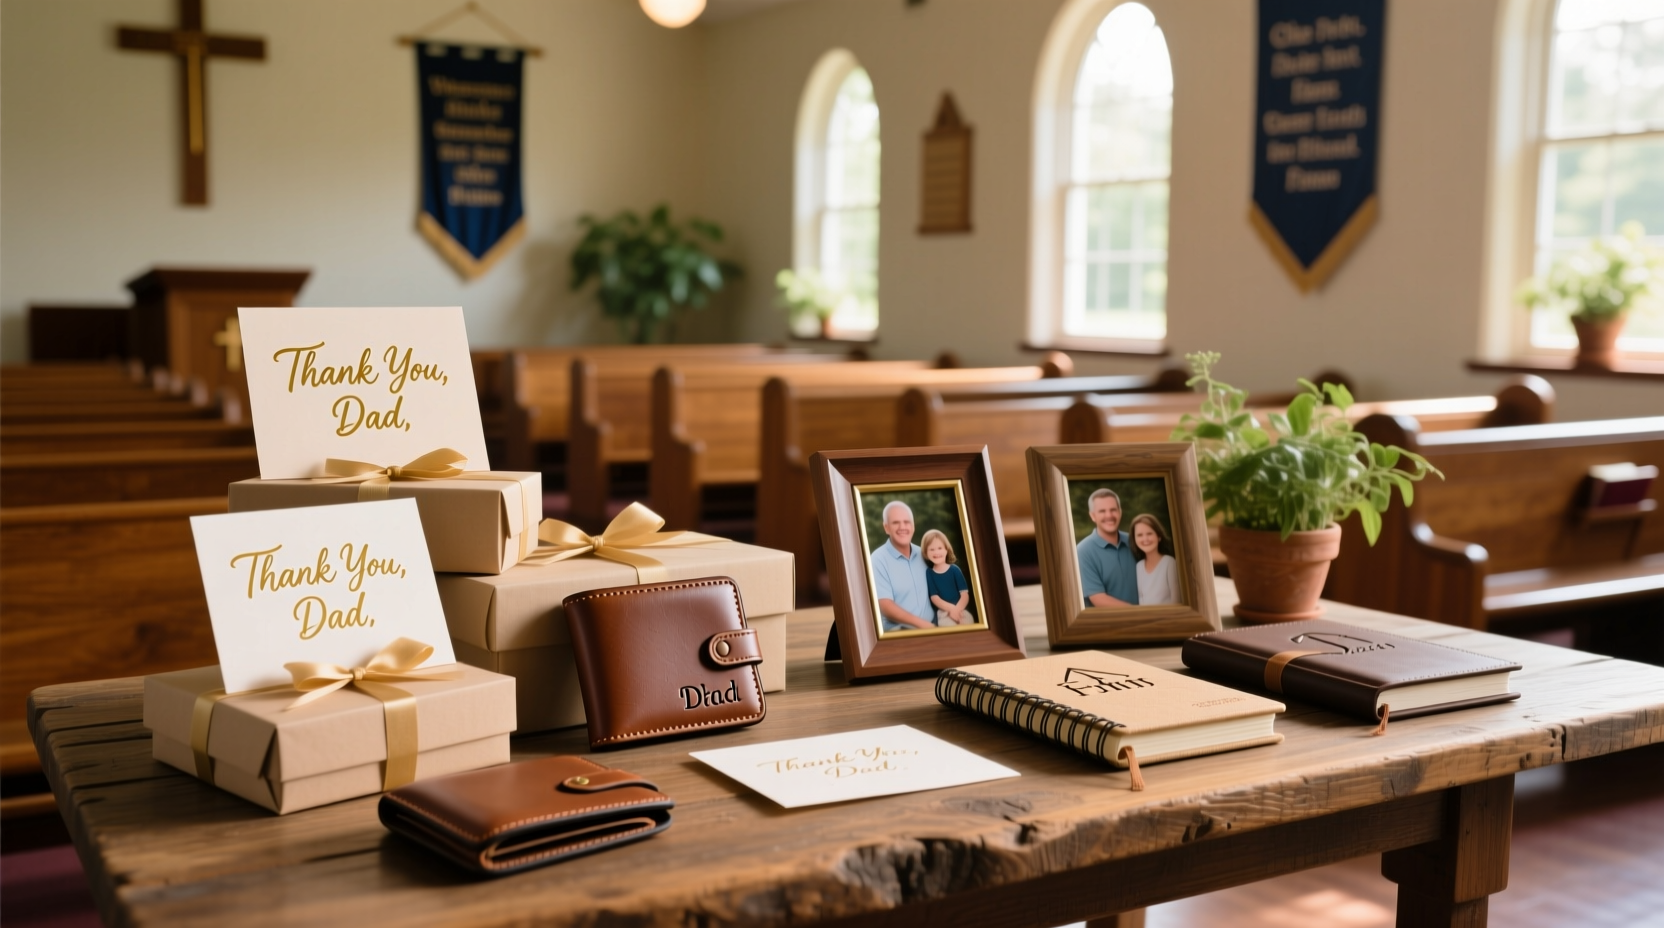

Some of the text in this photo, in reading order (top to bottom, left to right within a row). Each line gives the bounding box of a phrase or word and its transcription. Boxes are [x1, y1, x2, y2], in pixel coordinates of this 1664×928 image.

[272, 341, 449, 395] Thank You,
[331, 394, 411, 437] Dad,
[229, 542, 407, 599] Thank You,
[756, 752, 855, 773] Thank
